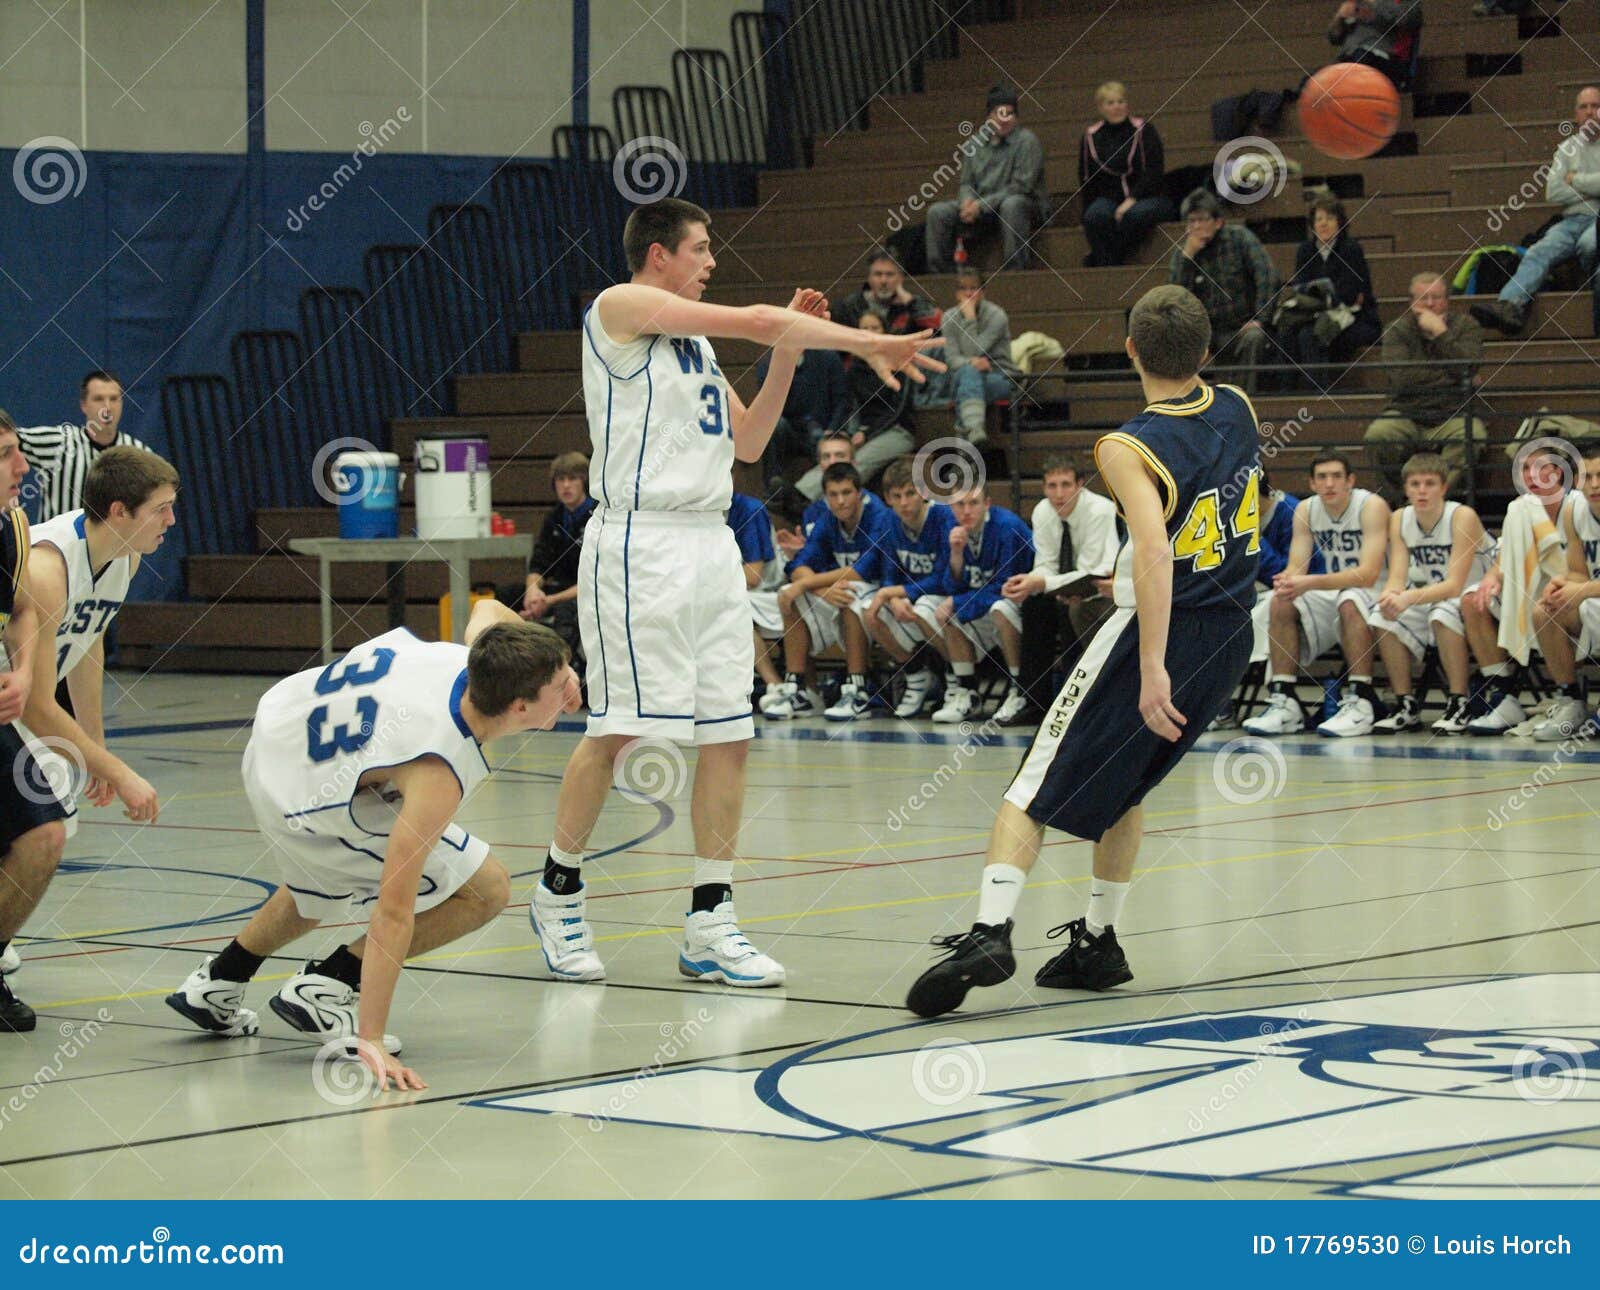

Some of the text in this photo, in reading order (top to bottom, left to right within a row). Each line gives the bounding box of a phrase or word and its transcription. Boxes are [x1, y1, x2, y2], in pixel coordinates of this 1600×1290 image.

[1169, 466, 1261, 573] 44
[307, 647, 396, 763] 33
[1049, 669, 1087, 738] POPES
